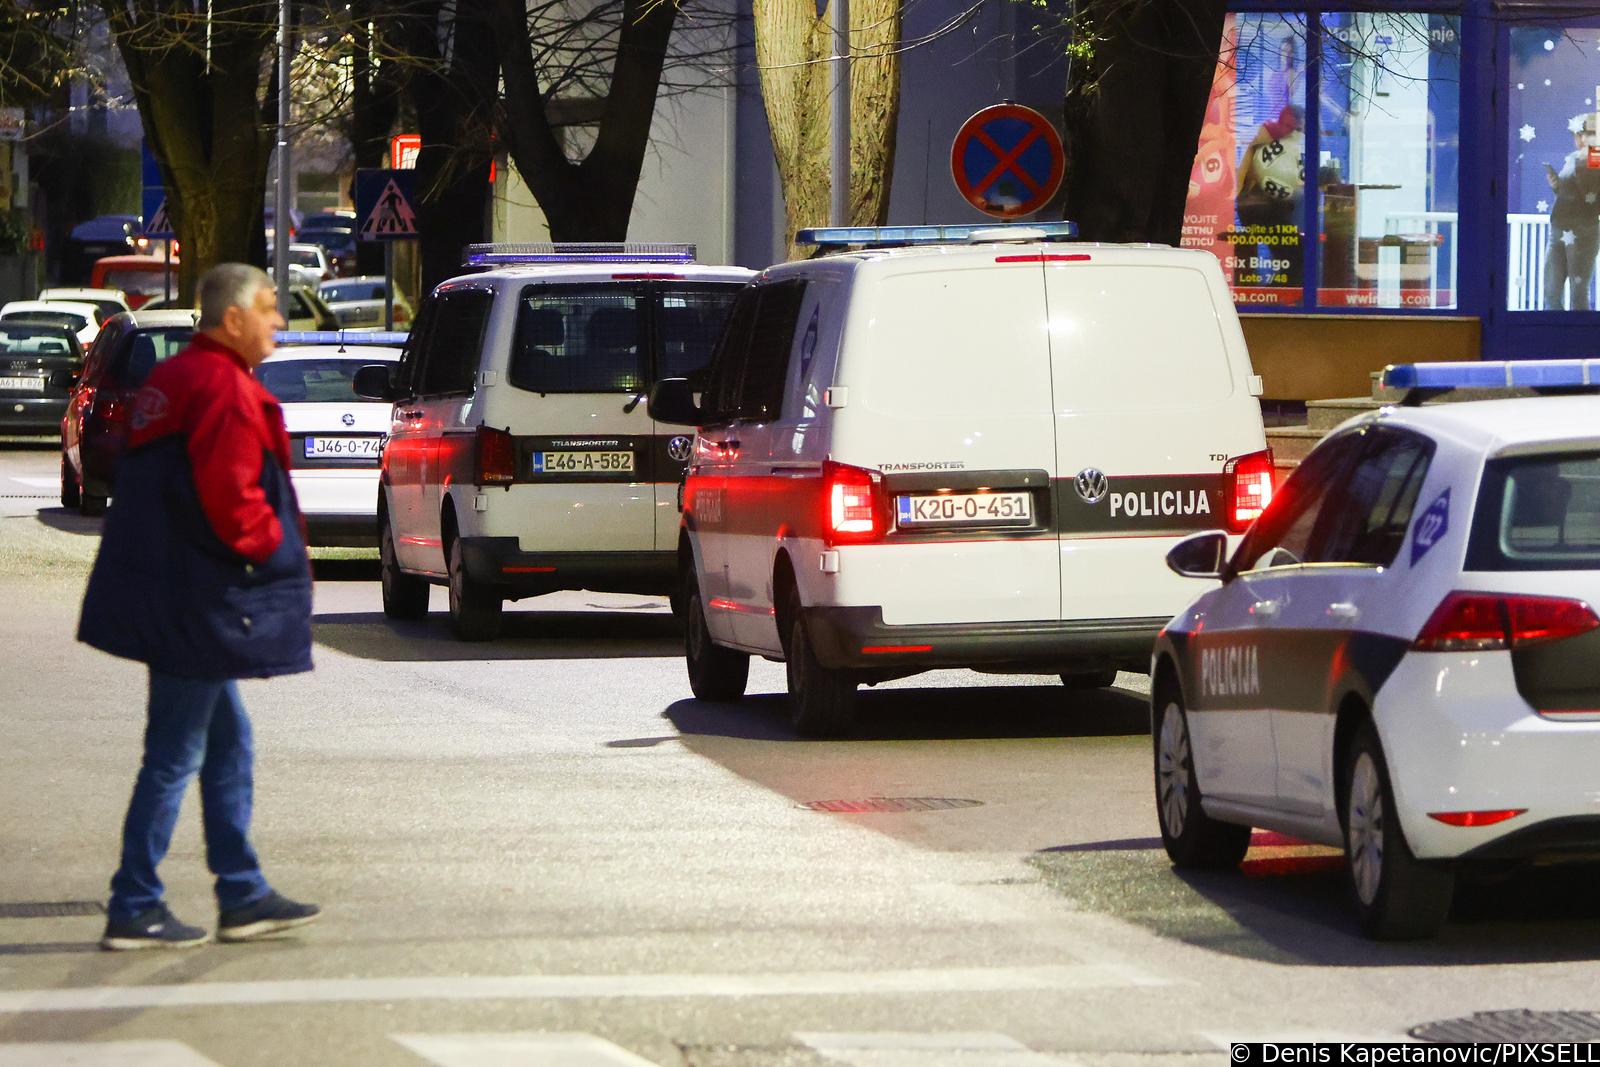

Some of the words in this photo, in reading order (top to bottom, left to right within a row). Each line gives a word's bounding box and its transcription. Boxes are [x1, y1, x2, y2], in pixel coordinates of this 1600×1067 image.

[1184, 214, 1218, 224] VOJITE
[1181, 225, 1214, 235] RETNU
[1226, 224, 1267, 235] Osvojite
[1180, 237, 1214, 246] ESTICU
[1281, 236, 1299, 245] KM
[1225, 256, 1246, 269] Six
[1249, 256, 1291, 271] Bingo
[1239, 274, 1263, 283] Loto
[545, 453, 632, 470] E46-A-582
[878, 461, 965, 471] TRANSPORTER
[1109, 489, 1211, 518] POLICIJA
[1201, 645, 1261, 697] POLICIJA
